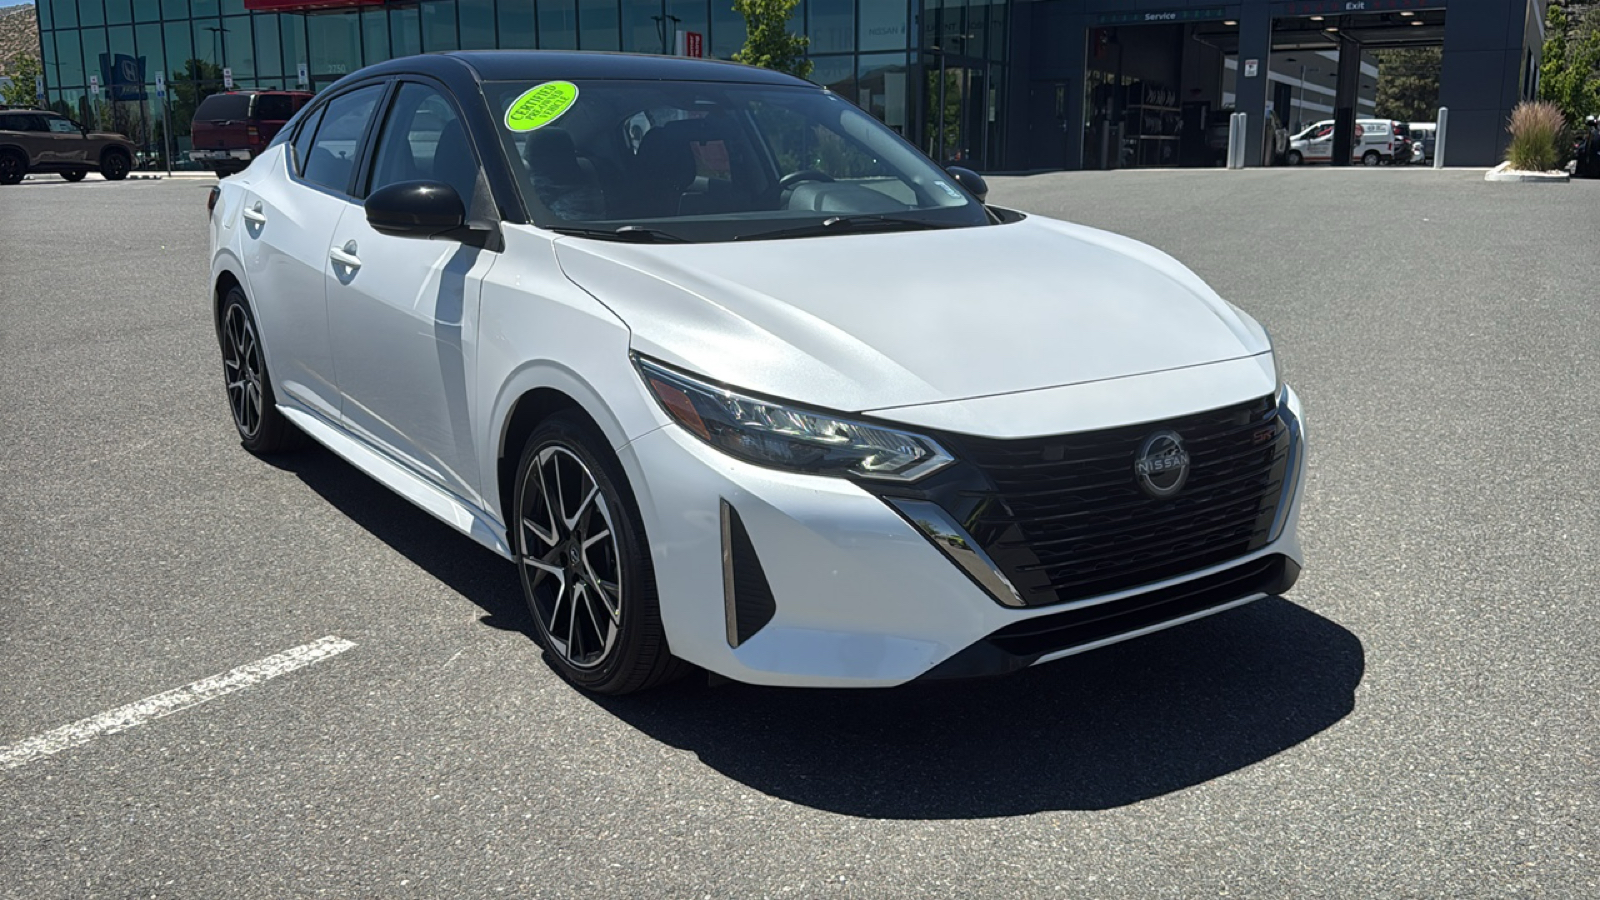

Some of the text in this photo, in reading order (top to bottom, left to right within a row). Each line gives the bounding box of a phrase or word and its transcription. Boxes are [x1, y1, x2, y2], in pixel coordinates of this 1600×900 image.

[1345, 1, 1365, 10] Exit
[1144, 12, 1176, 21] Service
[511, 85, 556, 120] CERTIFIED
[1138, 454, 1188, 472] NISSAN
